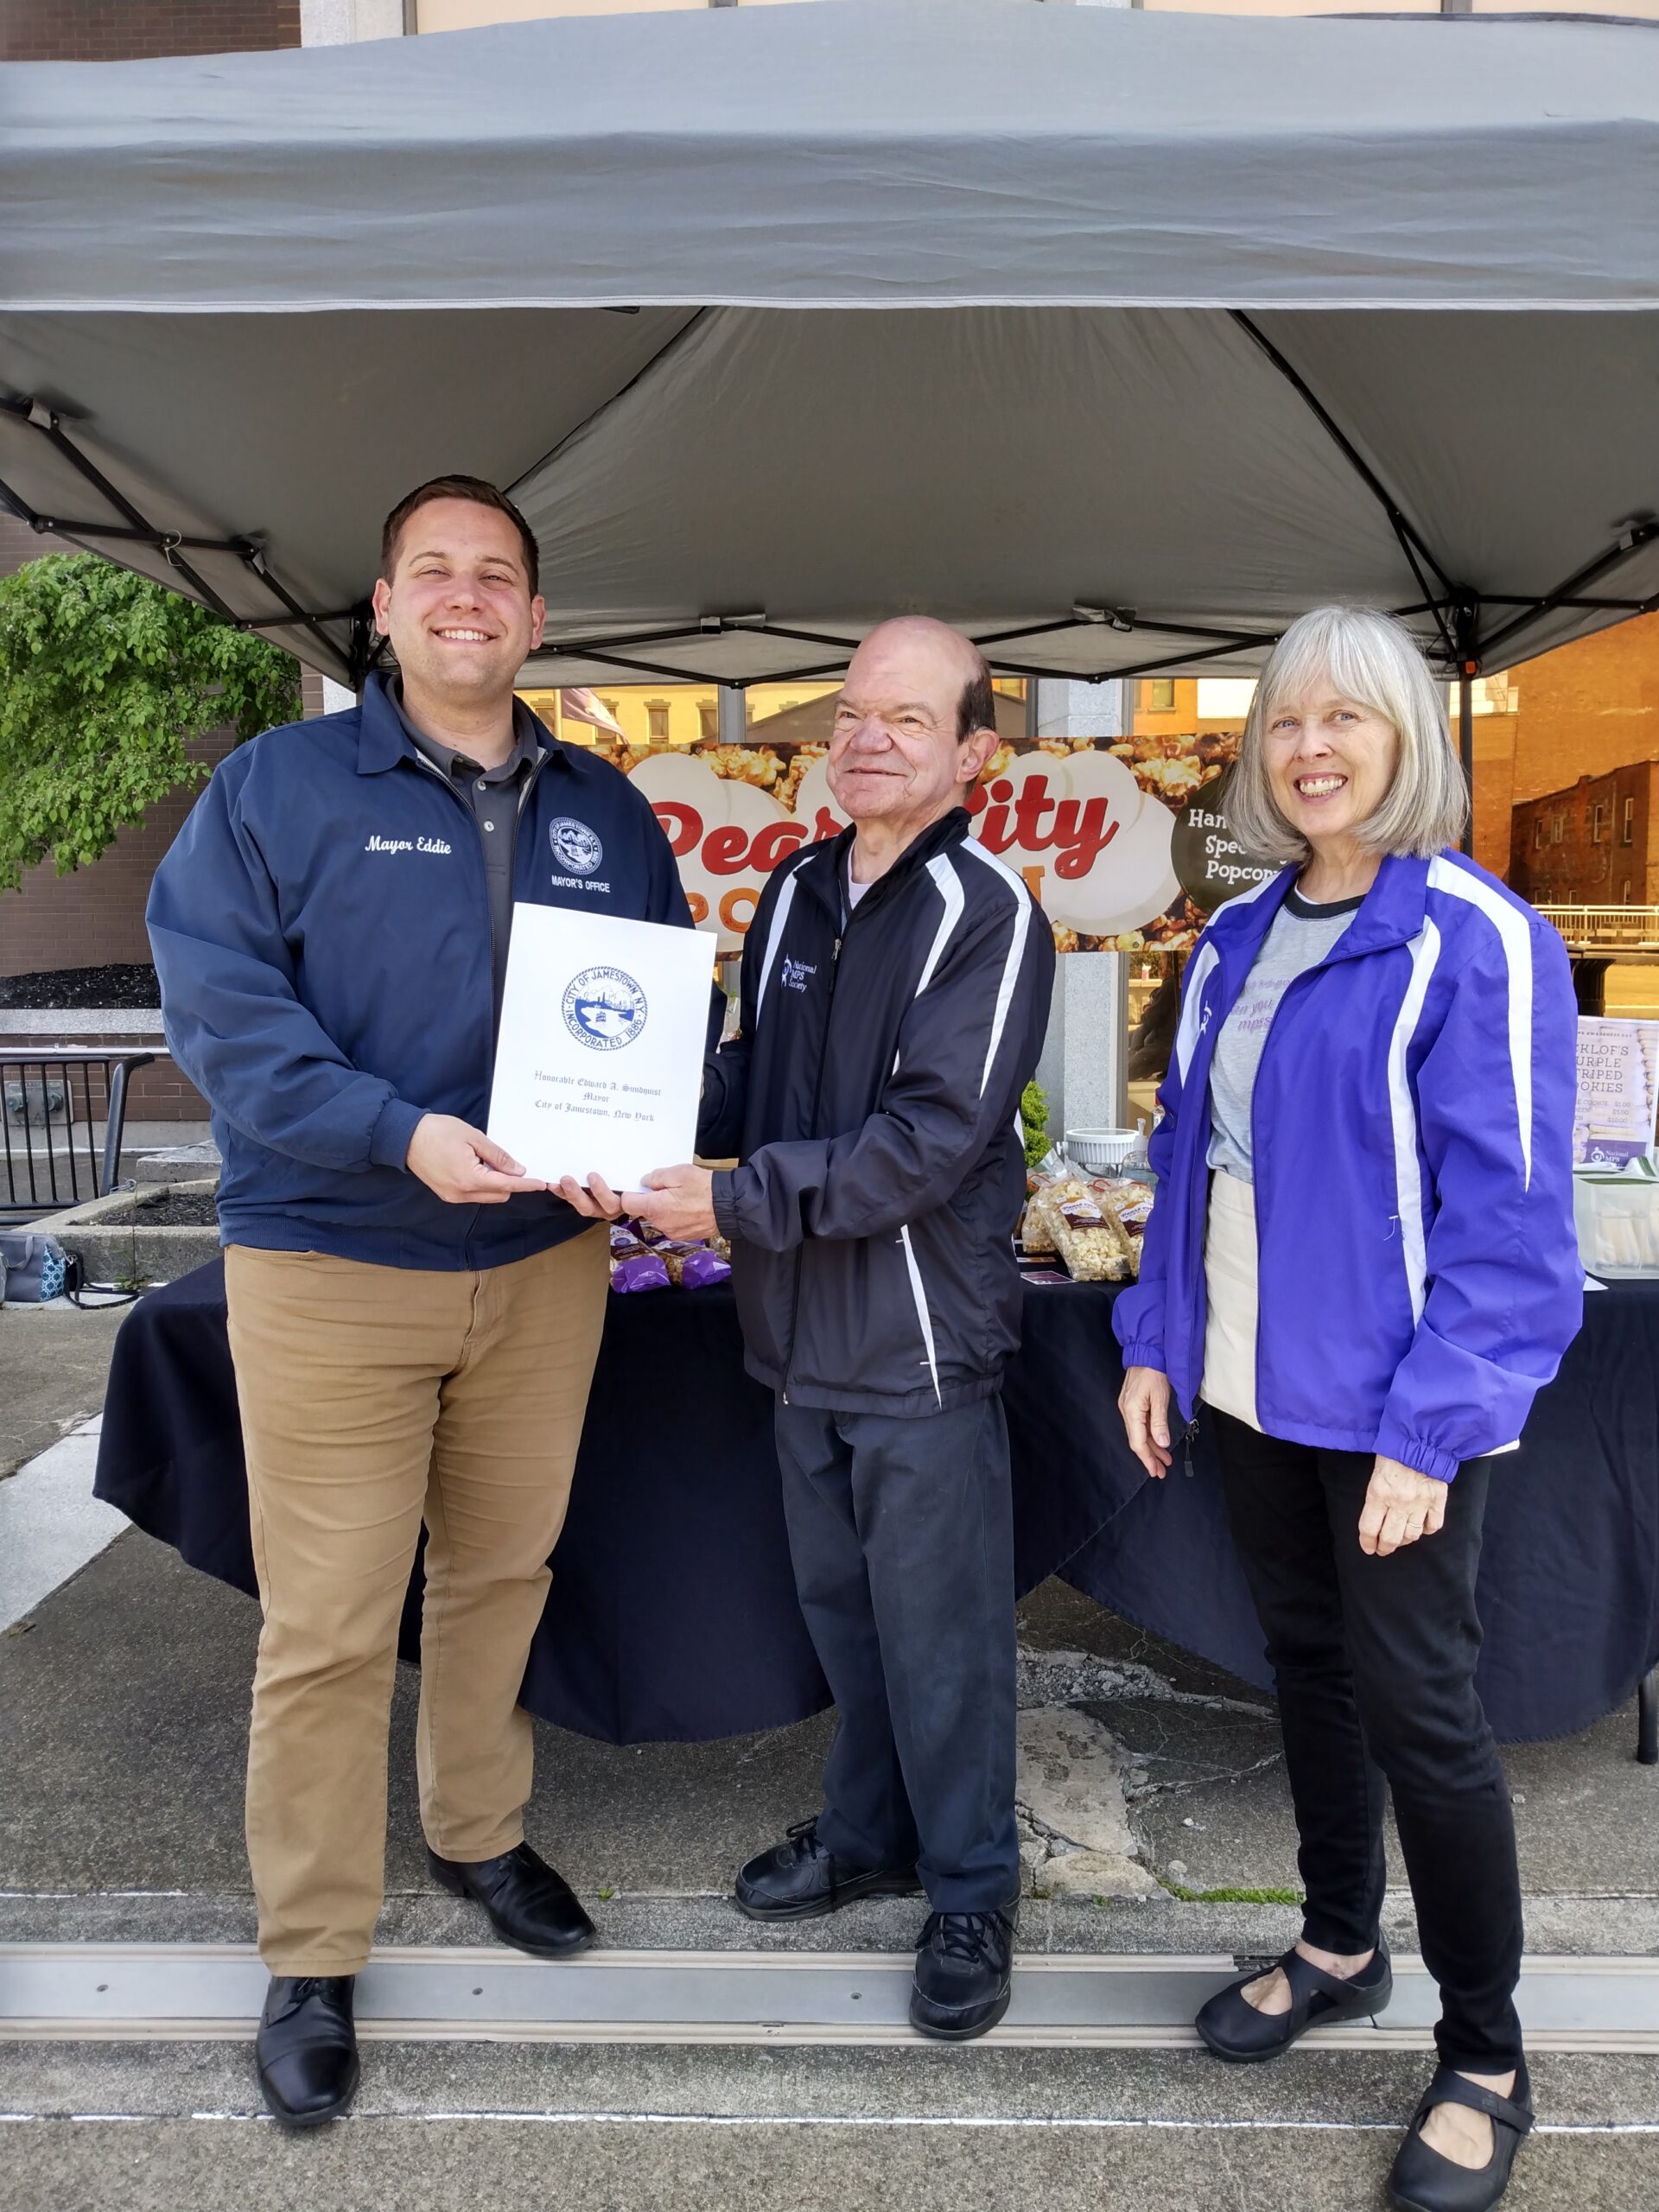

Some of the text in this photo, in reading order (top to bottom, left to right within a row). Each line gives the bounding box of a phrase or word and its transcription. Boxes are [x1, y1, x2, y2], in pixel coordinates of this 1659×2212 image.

[650, 775, 1121, 880] Pear ity
[1188, 809, 1227, 830] Han
[365, 836, 452, 855] Mayor Eddie
[1205, 860, 1280, 884] Popcor
[551, 874, 611, 893] MAYOR'S OFFICE
[791, 969, 805, 981] MPS
[793, 960, 817, 975] National
[566, 984, 580, 1005] CITY
[578, 974, 589, 987] OF
[591, 969, 639, 995] JAMESTOWN
[565, 1009, 643, 1048] INCORPORATED 1886
[1577, 1043, 1629, 1056] KLOF'S
[1576, 1056, 1622, 1068] URPLE
[534, 1070, 575, 1085] Honorable
[577, 1077, 607, 1090] Edward
[1577, 1081, 1624, 1093] OKIES
[582, 1092, 610, 1103] Mayor
[535, 1099, 552, 1109] City
[554, 1102, 563, 1110] of
[613, 1109, 632, 1119] New
[634, 1111, 655, 1122] York
